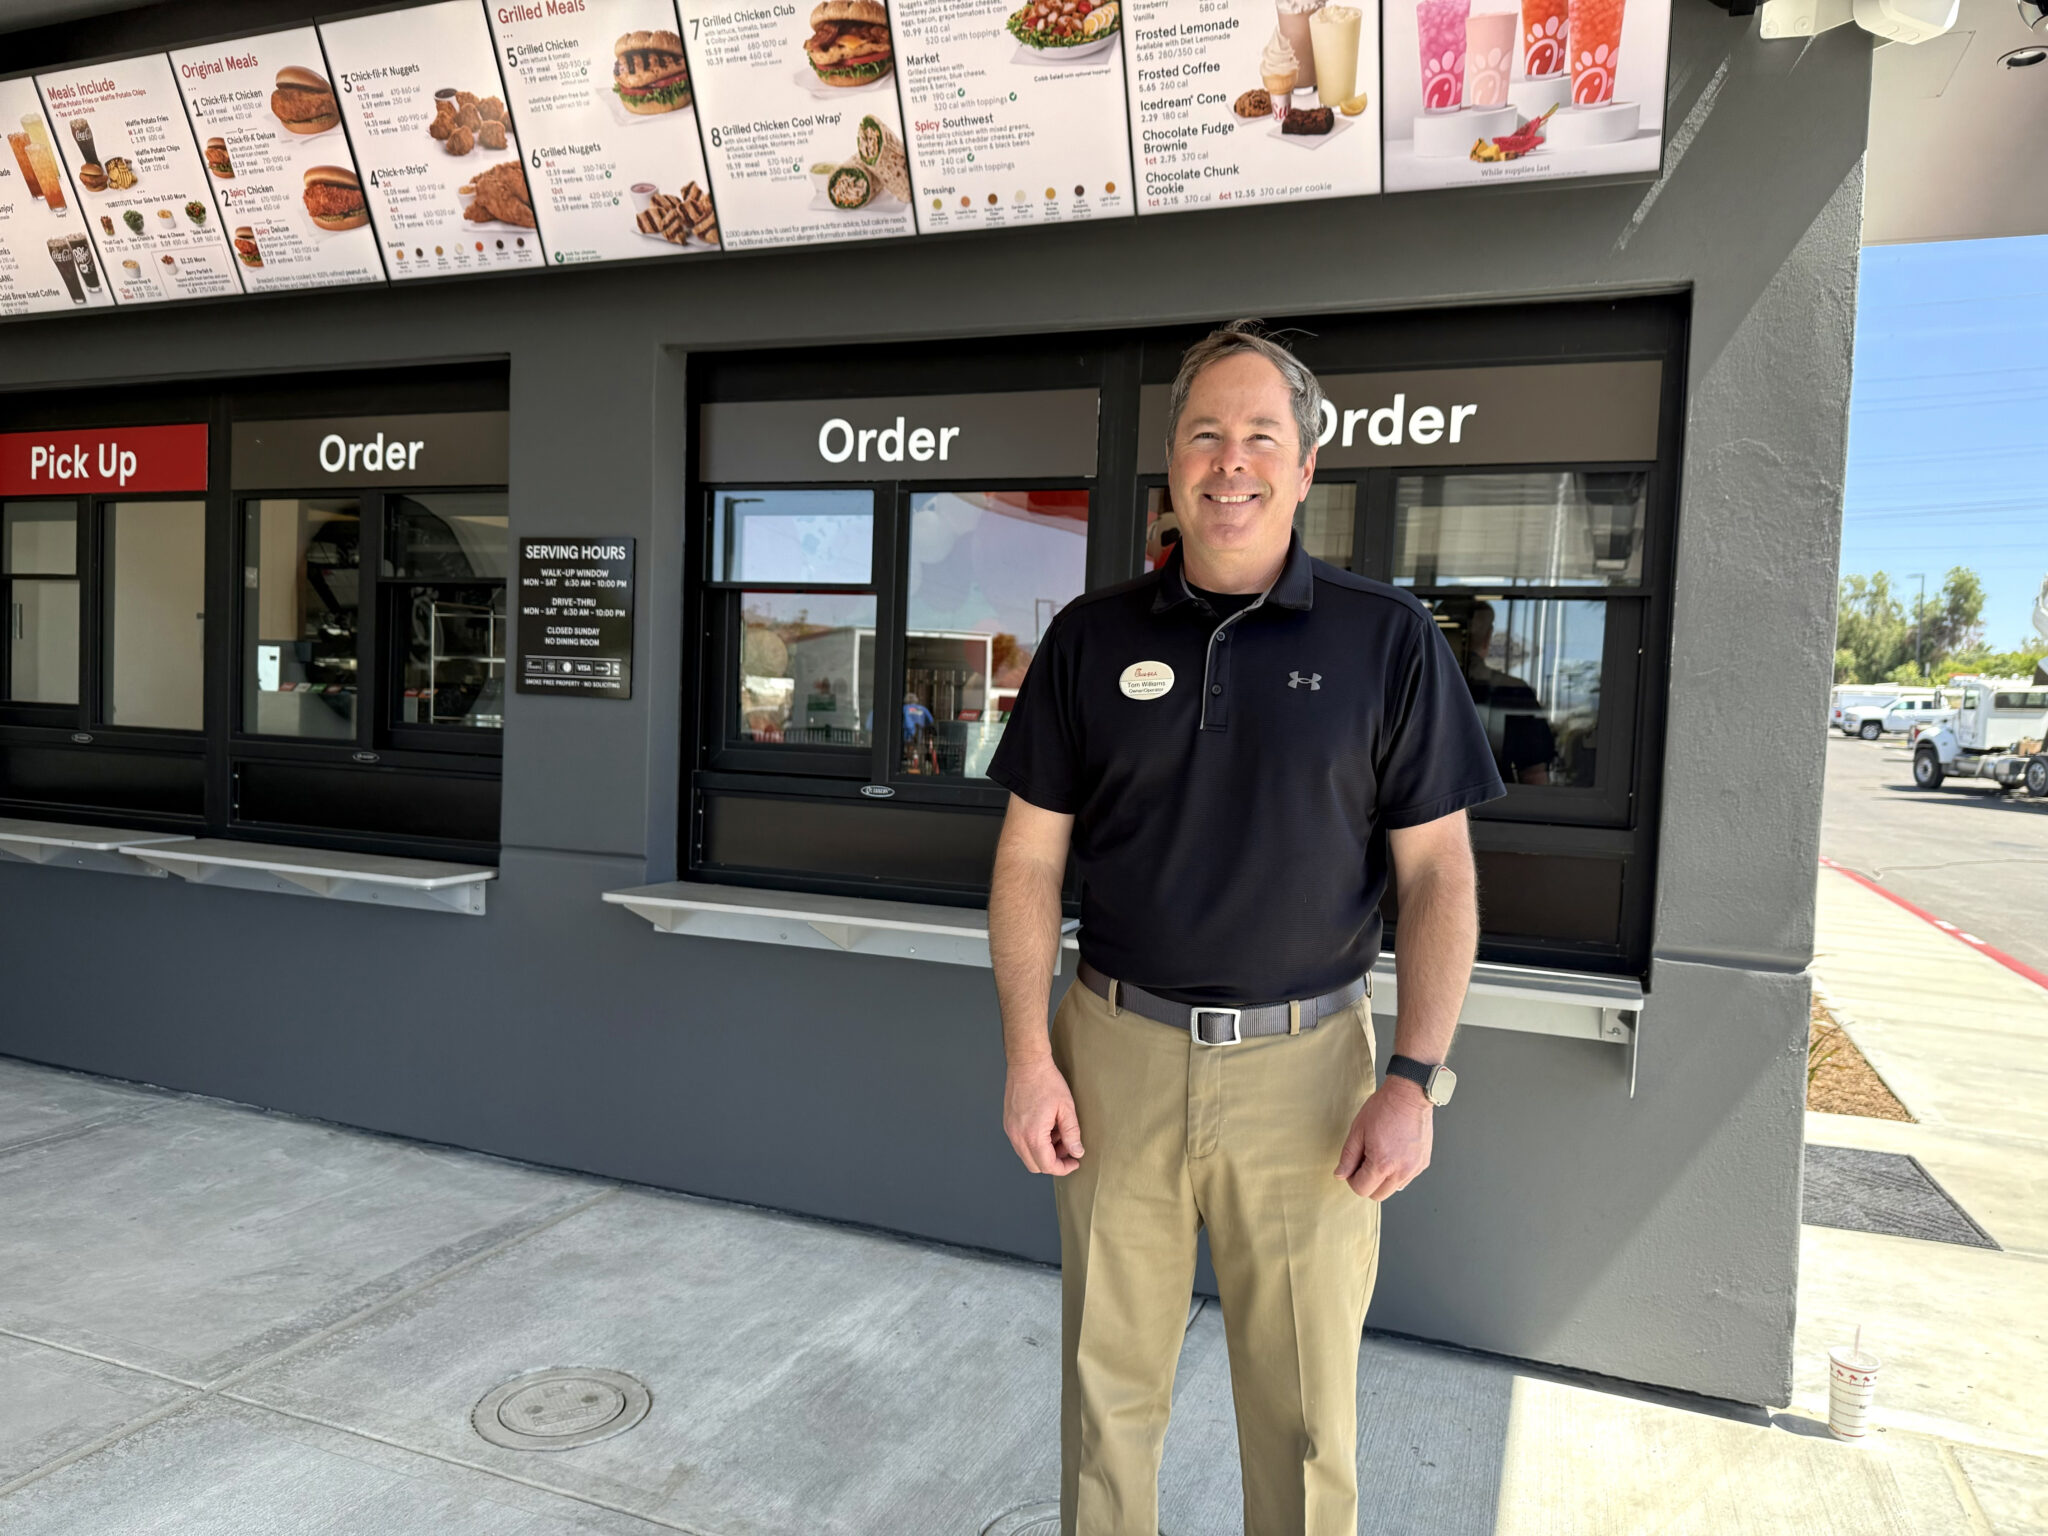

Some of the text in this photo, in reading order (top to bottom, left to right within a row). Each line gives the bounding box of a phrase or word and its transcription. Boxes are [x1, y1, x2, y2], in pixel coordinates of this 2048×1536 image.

[498, 0, 585, 24] Grilled Meals
[1133, 1, 1168, 11] Strawberry
[1217, 1, 1228, 10] cal
[690, 4, 795, 40] 7 Grilled Chicken Club
[1133, 13, 1154, 22] Vanilla
[903, 24, 950, 37] 10.99 440 cal
[1136, 18, 1239, 41] Frosted Lemonade
[926, 29, 1000, 45] 520 cal with toppings
[1136, 32, 1230, 50] Available with Diet Lemonade
[506, 39, 579, 67] 5 Grilled Chicken
[1195, 46, 1206, 54] cal
[182, 53, 258, 79] Original Meals
[907, 53, 940, 66] Market
[341, 74, 352, 93] 3
[390, 63, 420, 77] Nuggets
[1139, 62, 1220, 81] Frosted Coffee
[47, 77, 115, 101] Meals Include
[1160, 81, 1175, 89] 260
[1177, 79, 1188, 88] cal
[193, 99, 203, 117] 1
[236, 90, 263, 101] Chicken
[911, 91, 956, 104] 11.19 190 cal
[949, 101, 959, 109] cal
[961, 99, 975, 107] with
[977, 95, 1008, 106] toppings
[1197, 92, 1226, 104] Cone
[915, 113, 994, 132] Spicy Southwest
[1142, 110, 1189, 122] 2.29 180 cal
[257, 132, 275, 141] Deluxe
[711, 128, 721, 147] 8
[722, 123, 751, 135] Grilled
[754, 118, 789, 131] Chicken
[792, 116, 813, 127] Cool
[1143, 122, 1234, 141] Chocolate Fudge
[1144, 139, 1187, 153] Brownie
[532, 142, 601, 168] 6 Grilled Nuggets
[920, 156, 965, 168] 11.19 240 cal
[1145, 151, 1208, 165] 1ct 2.75 370 cal
[942, 160, 1015, 175] 390 cal with toppings
[1146, 164, 1239, 183] Chocolate Chunk
[1481, 168, 1502, 176] While
[1505, 166, 1534, 175] supplies
[371, 171, 379, 188] 4
[221, 185, 274, 207] 2 Spicy Chicken
[923, 185, 955, 195] Dressings
[1147, 183, 1184, 196] Cookie
[1148, 198, 1160, 206] 1ct
[1185, 194, 1198, 203] 370
[1200, 193, 1211, 201] cal
[1219, 192, 1231, 200] 6ct
[1260, 187, 1274, 196] 370
[1276, 185, 1287, 195] cal
[1290, 185, 1302, 195] per
[1305, 182, 1331, 193] cookie
[271, 225, 289, 233] Deluxe
[12, 291, 26, 300] Brew
[28, 290, 39, 298] Iced
[40, 288, 60, 296] Coffee
[818, 416, 960, 463] Order
[319, 432, 424, 473] Order
[31, 443, 137, 486] Pick Up
[525, 545, 626, 560] SERVING HOURS
[541, 568, 609, 578] WALK-UP WINDOW
[545, 579, 556, 587] SAT
[597, 580, 615, 588] 10:00
[617, 580, 627, 588] PM
[552, 598, 596, 607] DRIVE-THRU
[545, 608, 556, 616] SAT
[563, 608, 578, 616] 6:30
[596, 609, 614, 617] 10:00
[615, 609, 625, 617] PM
[547, 626, 600, 635] CLOSED SUNDAY
[545, 637, 555, 645] NO
[556, 638, 578, 646] DINING
[578, 664, 591, 672] VISA
